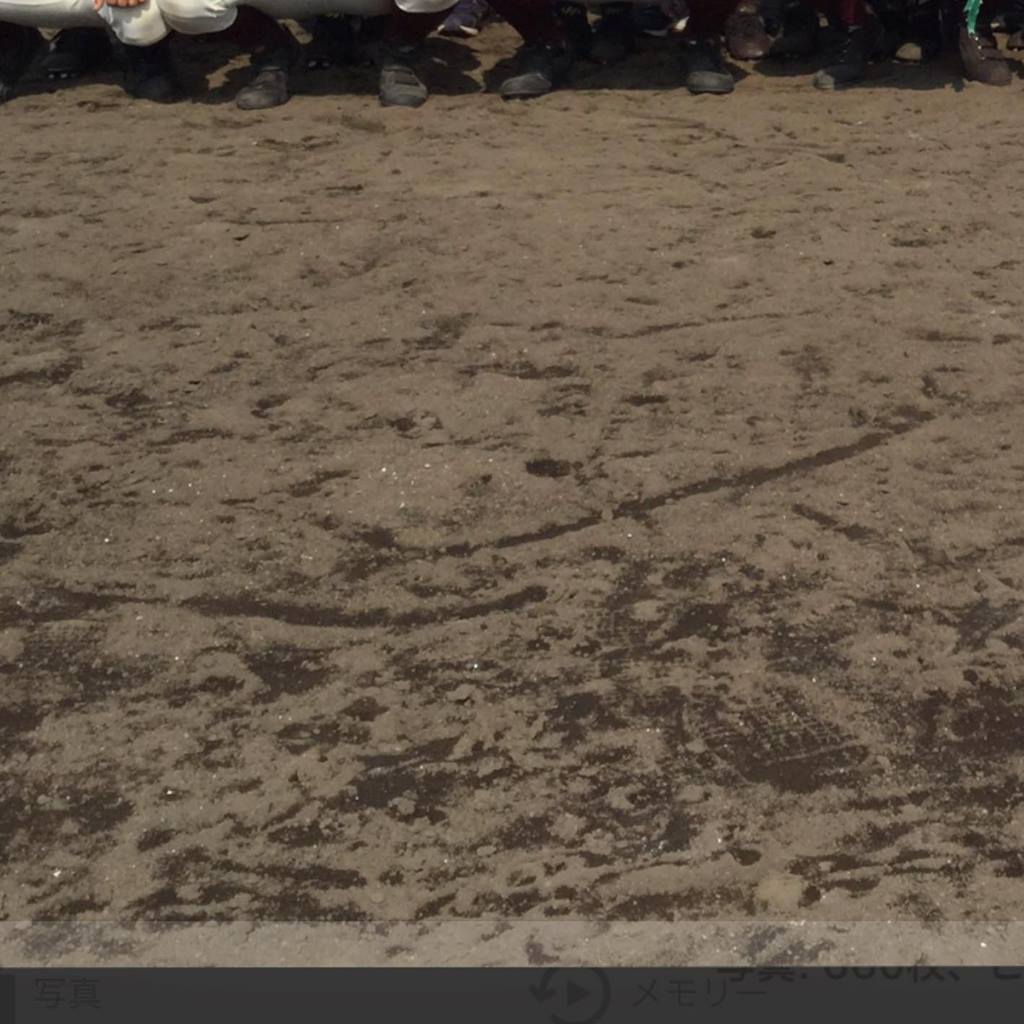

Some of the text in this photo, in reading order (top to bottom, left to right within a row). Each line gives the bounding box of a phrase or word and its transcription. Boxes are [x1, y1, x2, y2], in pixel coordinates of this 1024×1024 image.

[34, 977, 102, 1008] 写真
[632, 977, 768, 1008] メモリー
